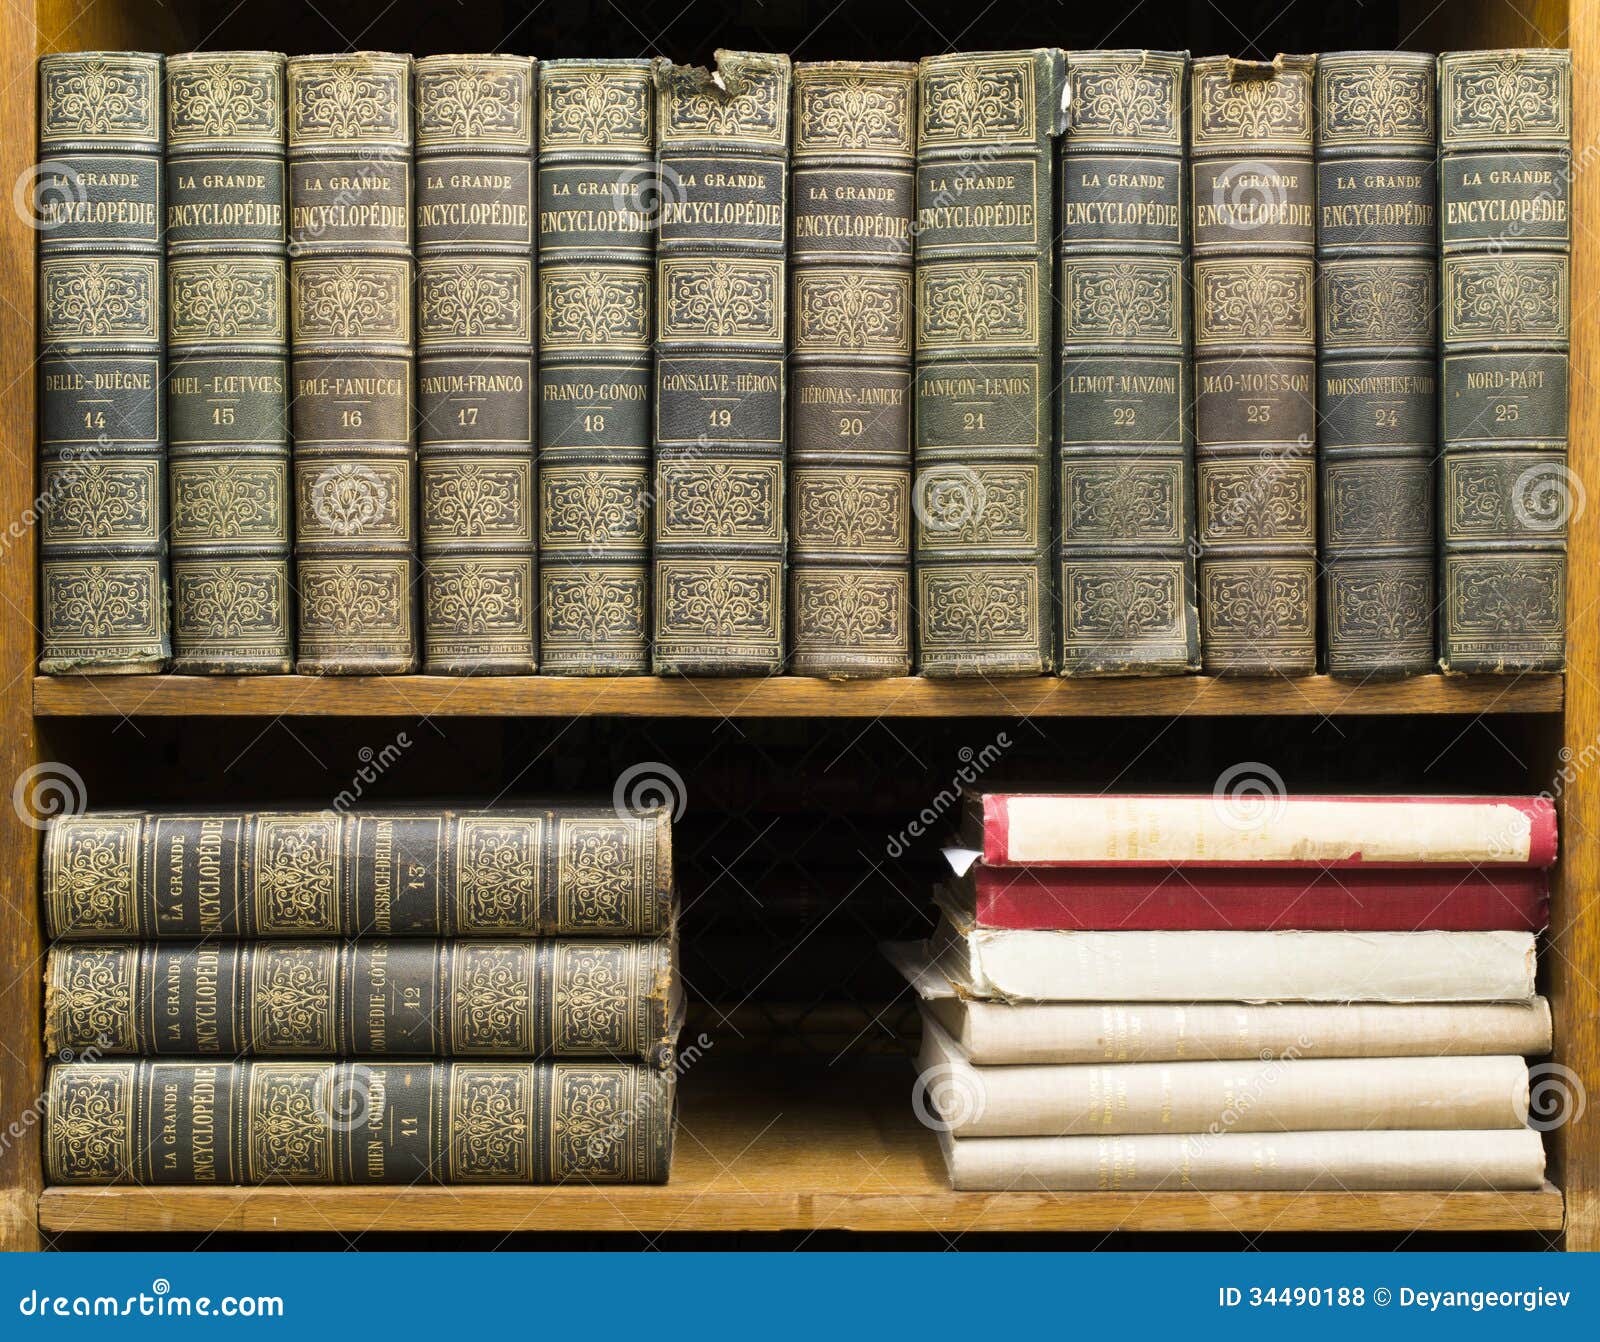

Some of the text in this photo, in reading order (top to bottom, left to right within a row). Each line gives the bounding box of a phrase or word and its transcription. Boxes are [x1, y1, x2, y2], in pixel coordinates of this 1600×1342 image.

[76, 173, 139, 187] GRANDE
[179, 174, 266, 189] LA GRANDE
[305, 177, 391, 190] LA GRANDE
[427, 175, 512, 190] LA GRANDE
[678, 173, 766, 189] LA GRANDE
[930, 176, 1016, 192] LA GRANDE
[1082, 173, 1165, 188] LA GRANDE
[1212, 175, 1298, 189] LA GRANDE
[1337, 175, 1422, 189] LA GRANDE
[1463, 171, 1552, 186] LA GRANDE
[552, 182, 639, 196] LA GRANDE
[810, 187, 896, 201] LA GRANDE
[168, 200, 282, 228] ENCYCLOPÉDIE
[293, 202, 406, 229] ENCYCLOPÉDIE
[417, 200, 529, 228] ENCYCLOPÉDIE
[663, 200, 781, 227] ENCYCLOPÉDIE
[919, 201, 1034, 230] ENCYCLOPÉDIE
[1066, 200, 1179, 227] ENCYCLOPÉDIE
[1198, 200, 1312, 227] ENCYCLOPÉDIE
[1322, 200, 1433, 228] ENCYCLOPÉDIE
[1447, 196, 1567, 224] ENCYCLOPÉDIE
[796, 212, 910, 239] ENCYCLOPÉDIE
[1069, 375, 1176, 395] LEMOT-MANZONI
[1203, 374, 1309, 393] MAO-MOISSON
[1467, 370, 1545, 389] NORD-PART
[544, 383, 648, 401] FRANCO-GONON
[84, 411, 106, 429] 14
[212, 408, 234, 425] 15
[341, 410, 362, 427] 16
[457, 407, 479, 425] 17
[709, 410, 732, 427] 19
[964, 413, 985, 430] 21
[1113, 408, 1136, 425] 22
[1247, 405, 1270, 423] 23
[1375, 409, 1398, 427] 24
[1495, 405, 1519, 422] 25
[583, 415, 605, 432] 18
[840, 418, 863, 436] 20
[170, 835, 185, 921] LA GRANDE
[196, 820, 224, 933] ENCYCLOPÉDIE
[408, 864, 426, 889] 13
[167, 956, 182, 1041] LA GRANDE
[403, 987, 420, 1009] 12
[164, 1084, 178, 1169] LA GRANDE
[189, 1067, 216, 1180] ENCYCLOPÉDIE
[400, 1116, 418, 1137] 11
